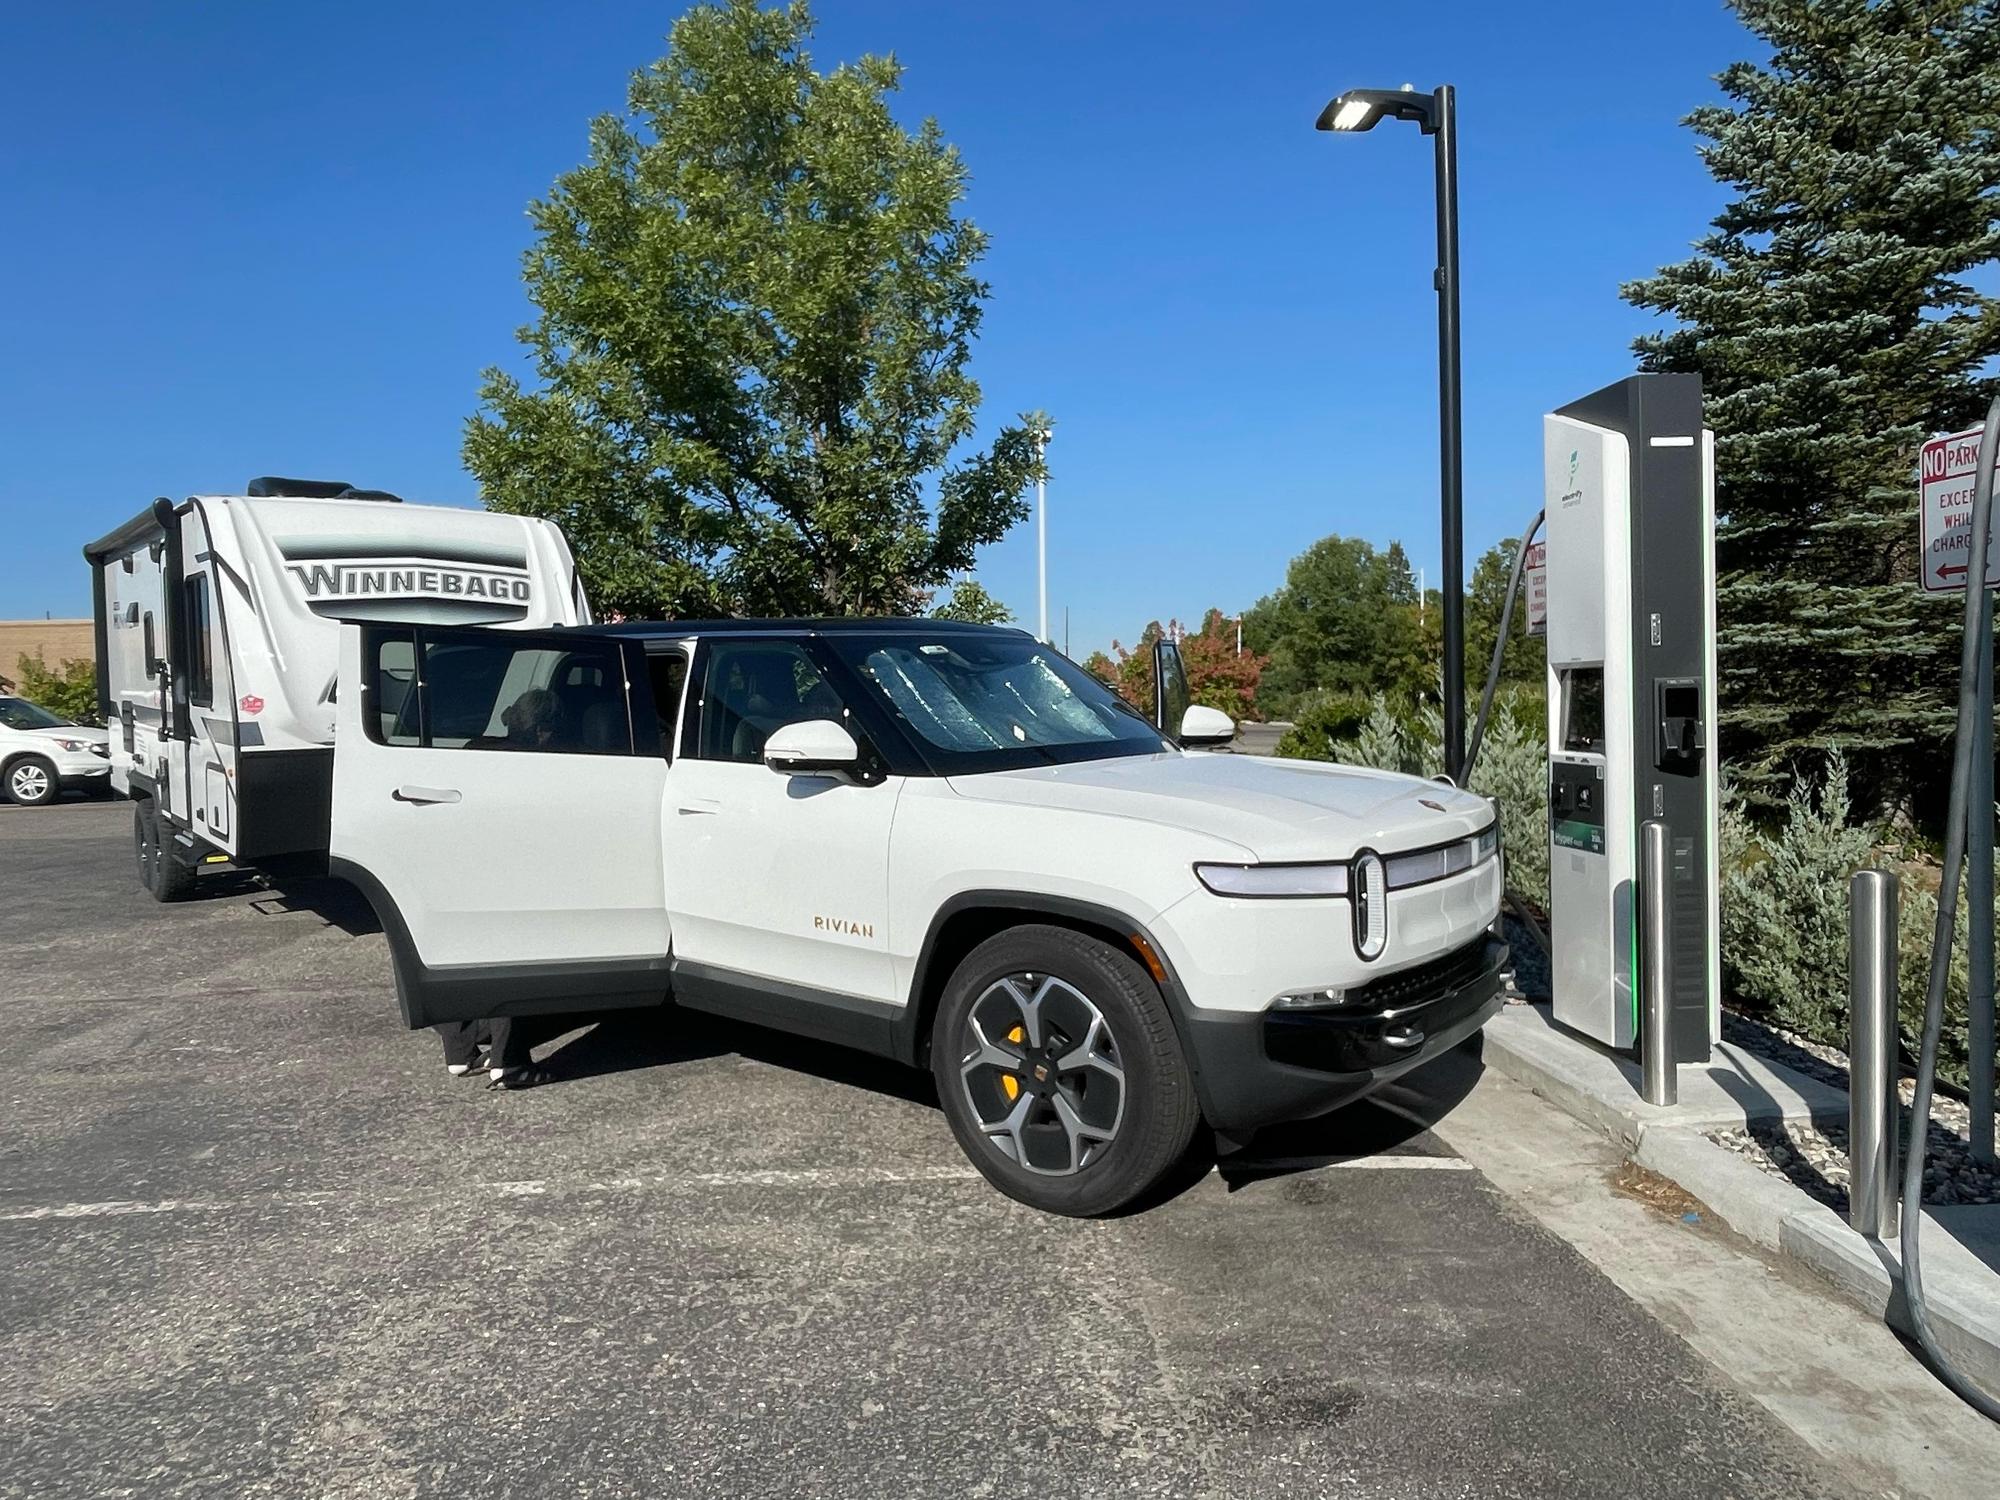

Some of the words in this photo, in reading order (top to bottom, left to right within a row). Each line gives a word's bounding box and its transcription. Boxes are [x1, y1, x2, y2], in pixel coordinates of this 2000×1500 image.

[1923, 447, 1946, 479] NO
[1948, 444, 1979, 468] PARK
[1940, 489, 1976, 508] EXCEP
[1944, 512, 1972, 528] WHIL
[284, 563, 531, 602] WINNEBAGO
[814, 916, 873, 938] RIVIAN
